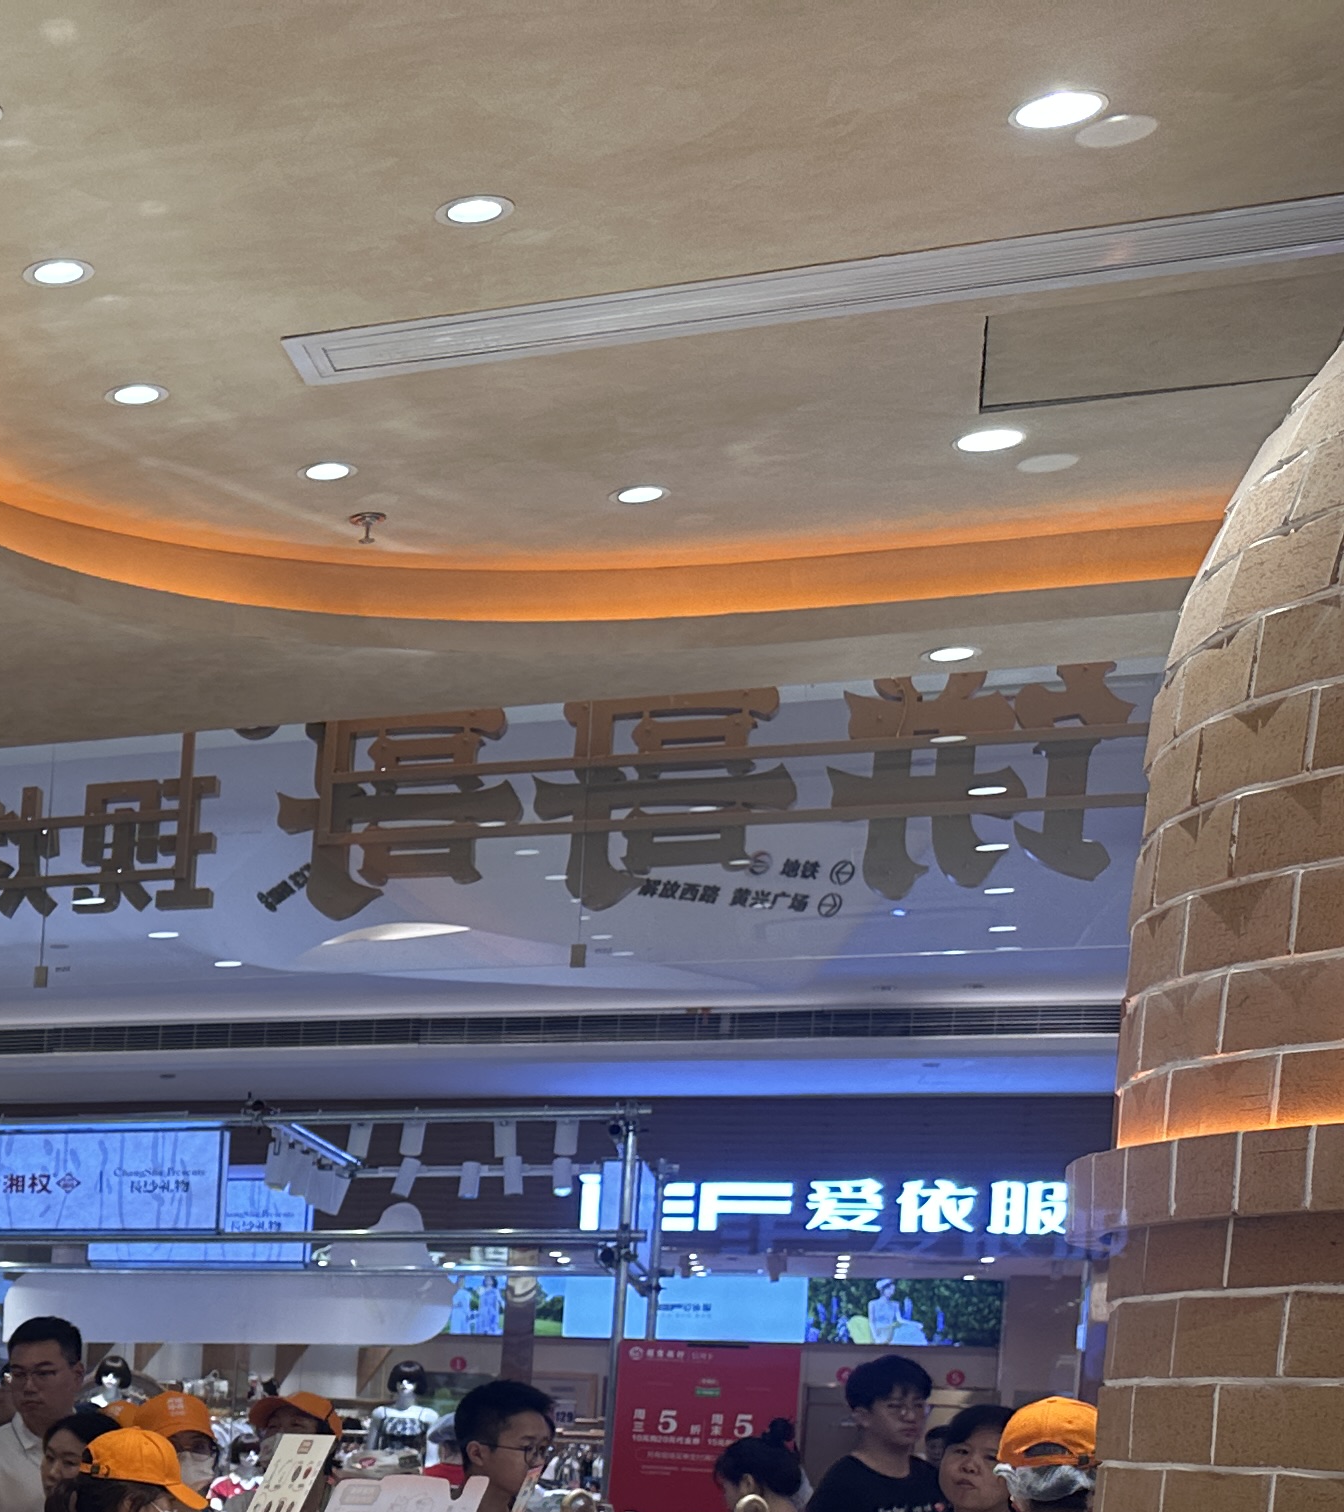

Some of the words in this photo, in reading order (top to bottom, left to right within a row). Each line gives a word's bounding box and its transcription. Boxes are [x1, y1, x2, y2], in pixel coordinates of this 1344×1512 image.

[780, 858, 821, 880] 地铁
[638, 877, 721, 905] 解放西路
[729, 886, 810, 913] 黄兴广场
[805, 1178, 1069, 1235] 爱依服
[657, 1410, 678, 1433] 5
[734, 1414, 753, 1437] 5
